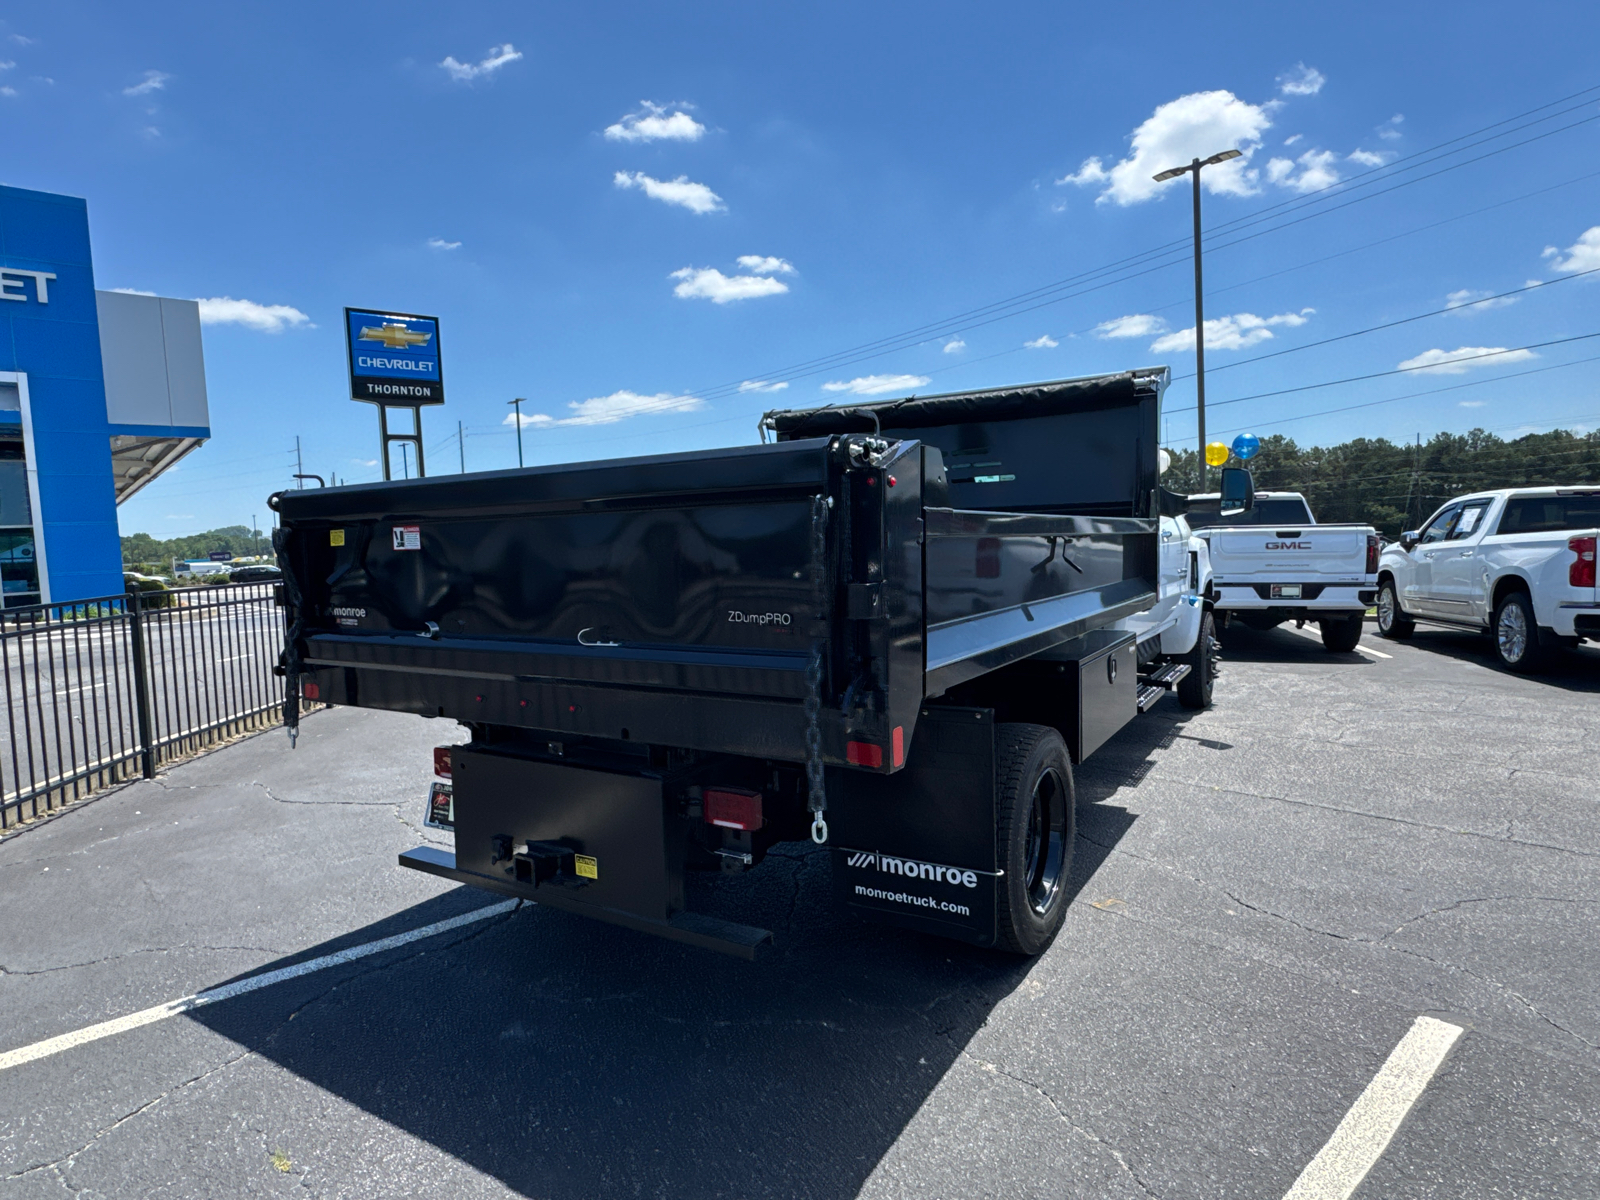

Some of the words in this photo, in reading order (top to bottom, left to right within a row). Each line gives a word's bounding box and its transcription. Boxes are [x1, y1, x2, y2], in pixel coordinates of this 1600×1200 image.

[358, 356, 434, 372] CHEVROLET
[367, 383, 431, 396] THORNTON
[1265, 541, 1312, 550] GMC
[333, 607, 366, 617] monroe
[728, 610, 791, 625] ZDumpPRO
[881, 856, 978, 888] monroe
[855, 885, 970, 916] monroetruck.com
